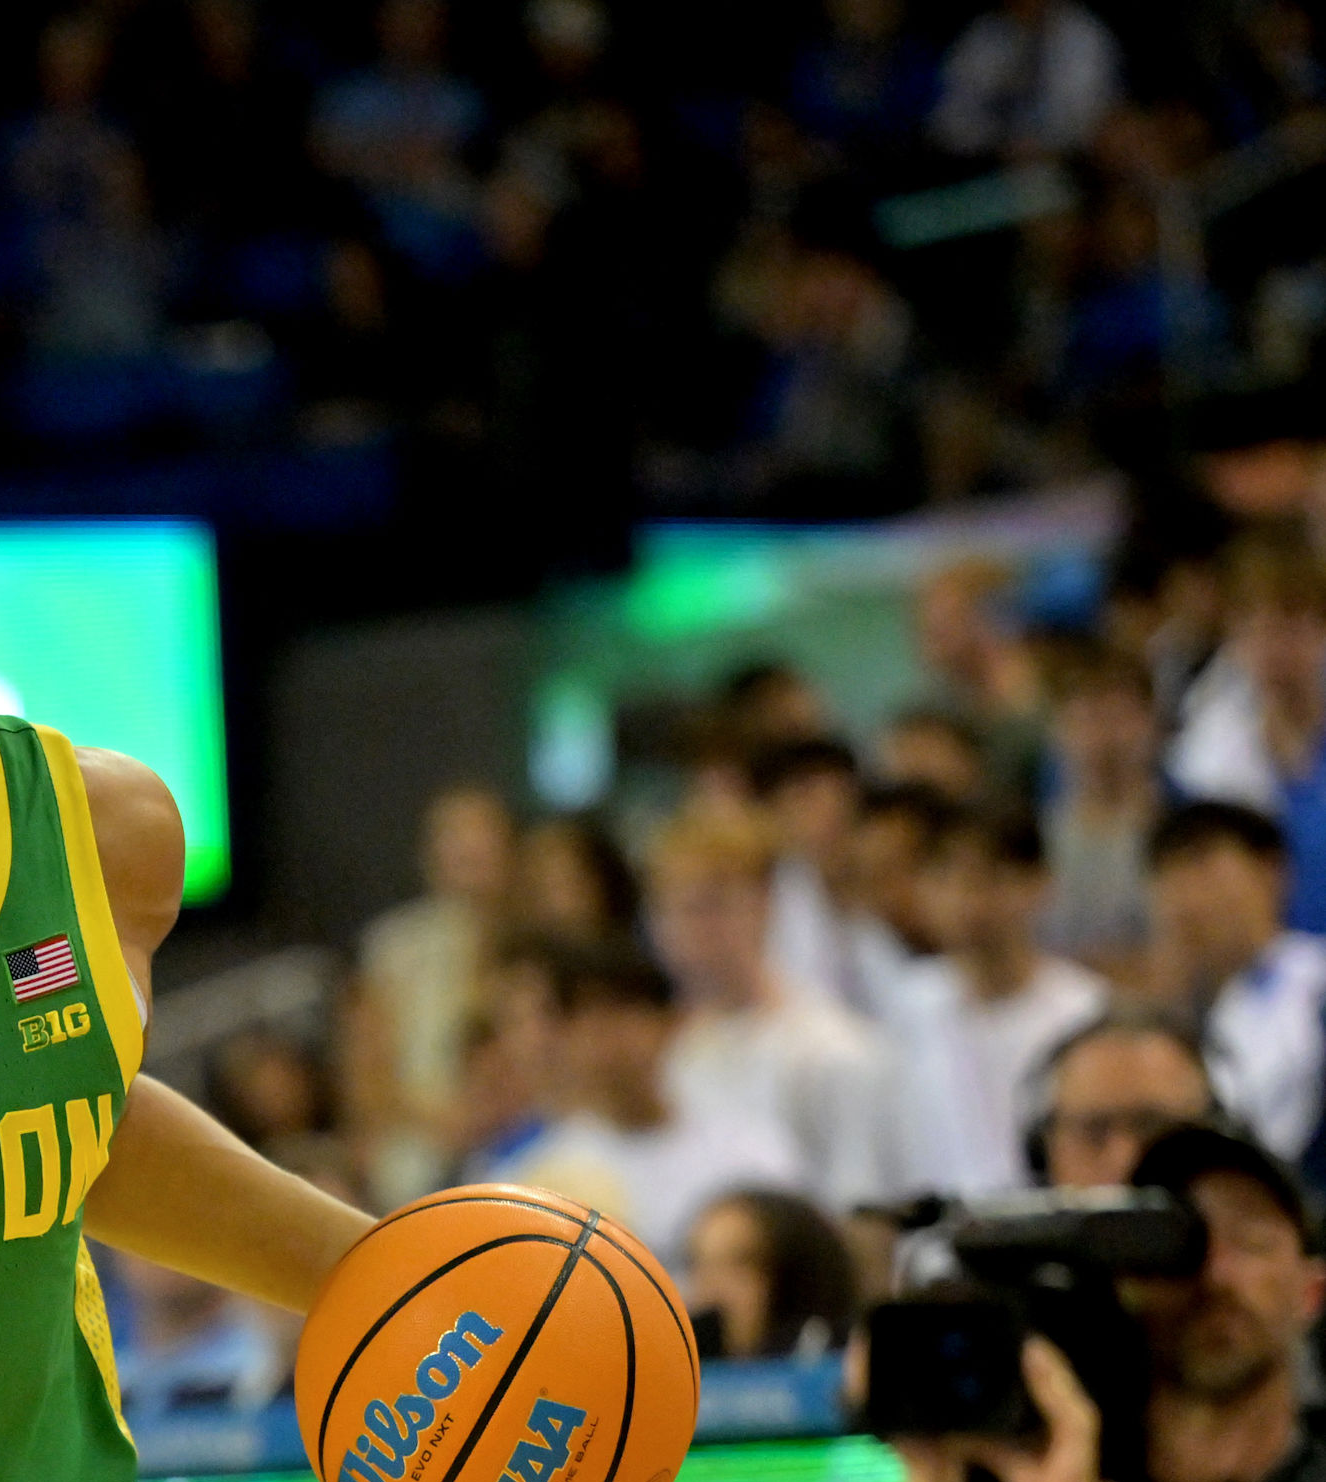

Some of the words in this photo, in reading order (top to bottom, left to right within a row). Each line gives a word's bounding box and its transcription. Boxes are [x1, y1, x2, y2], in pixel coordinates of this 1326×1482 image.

[411, 1450, 433, 1482] EVO
[430, 1412, 454, 1447] NXT
[575, 1416, 600, 1463] BALL
